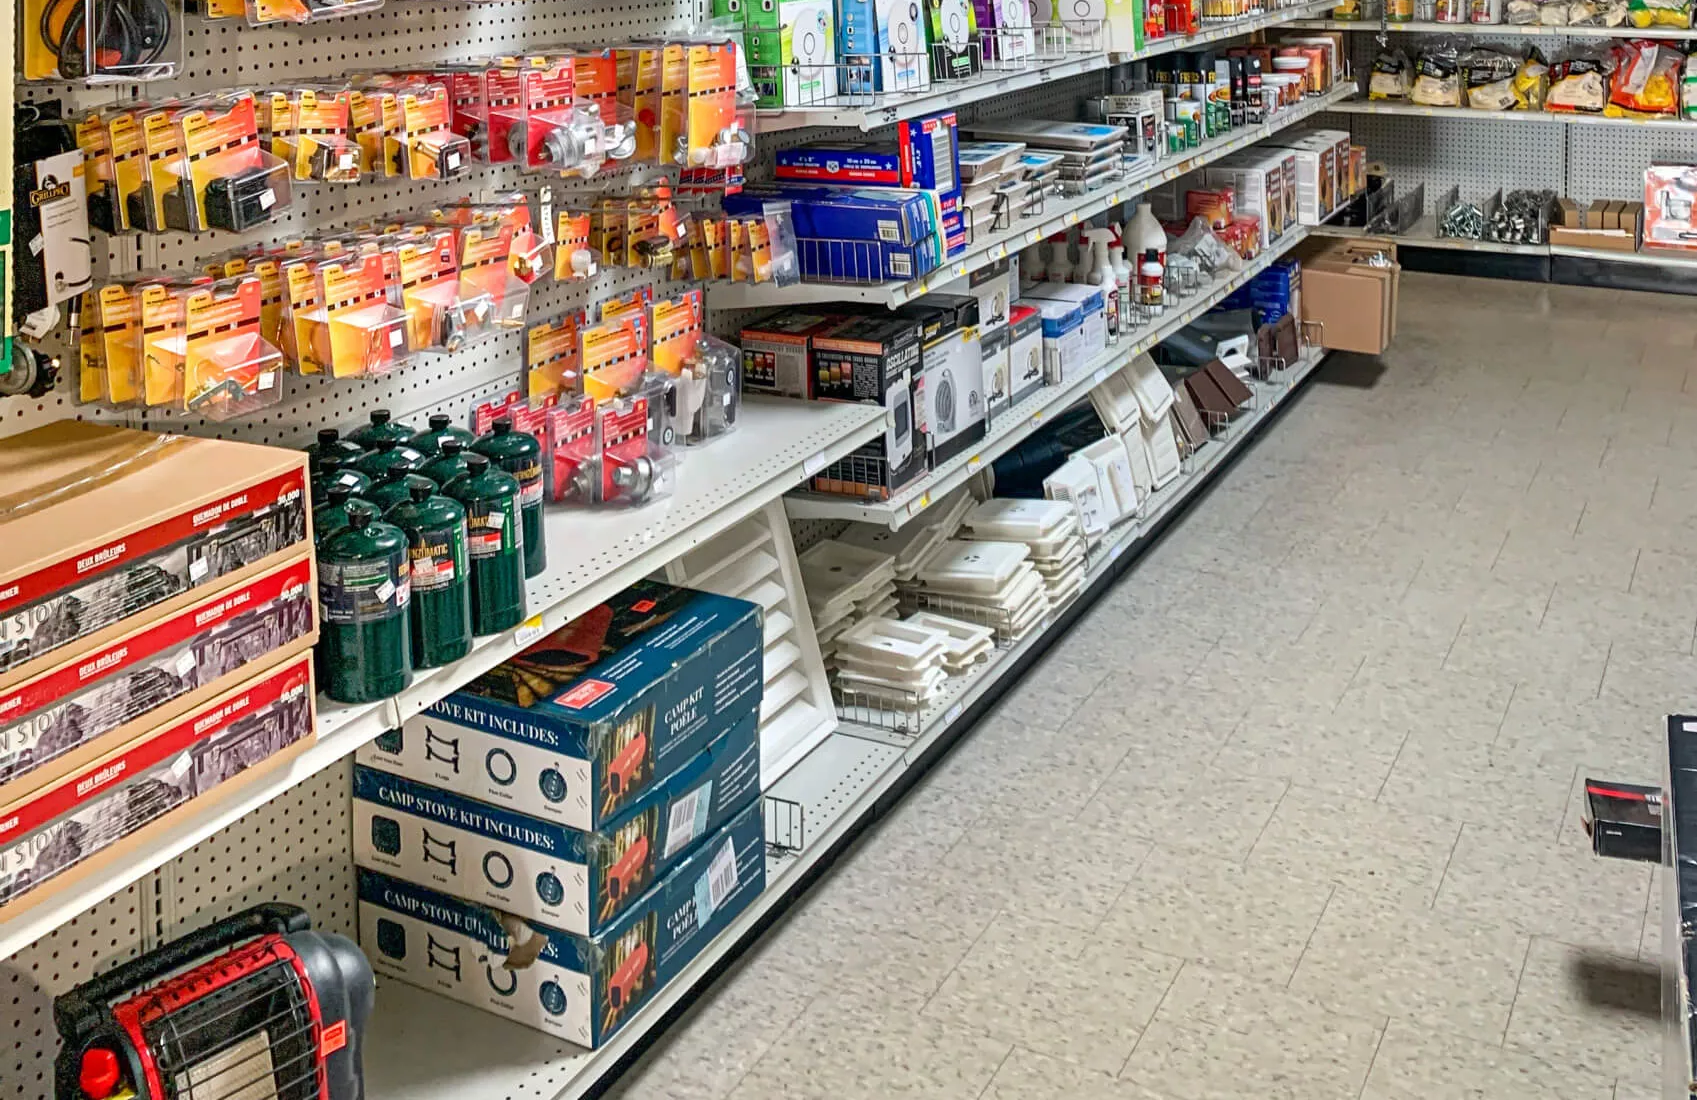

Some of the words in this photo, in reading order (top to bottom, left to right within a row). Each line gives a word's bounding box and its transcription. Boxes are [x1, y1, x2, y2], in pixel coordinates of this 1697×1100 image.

[77, 557, 93, 570] DEUX
[79, 662, 95, 677] DEUX
[465, 709, 487, 726] KIT
[489, 714, 559, 746] INCLUDES:
[77, 779, 93, 792] DEUX
[379, 787, 414, 807] CAMP
[416, 797, 457, 820] STOVE
[460, 811, 483, 828] KIT
[485, 817, 555, 850] INCLUDES:
[385, 890, 420, 911] CAMP
[421, 902, 463, 926] STOVE
